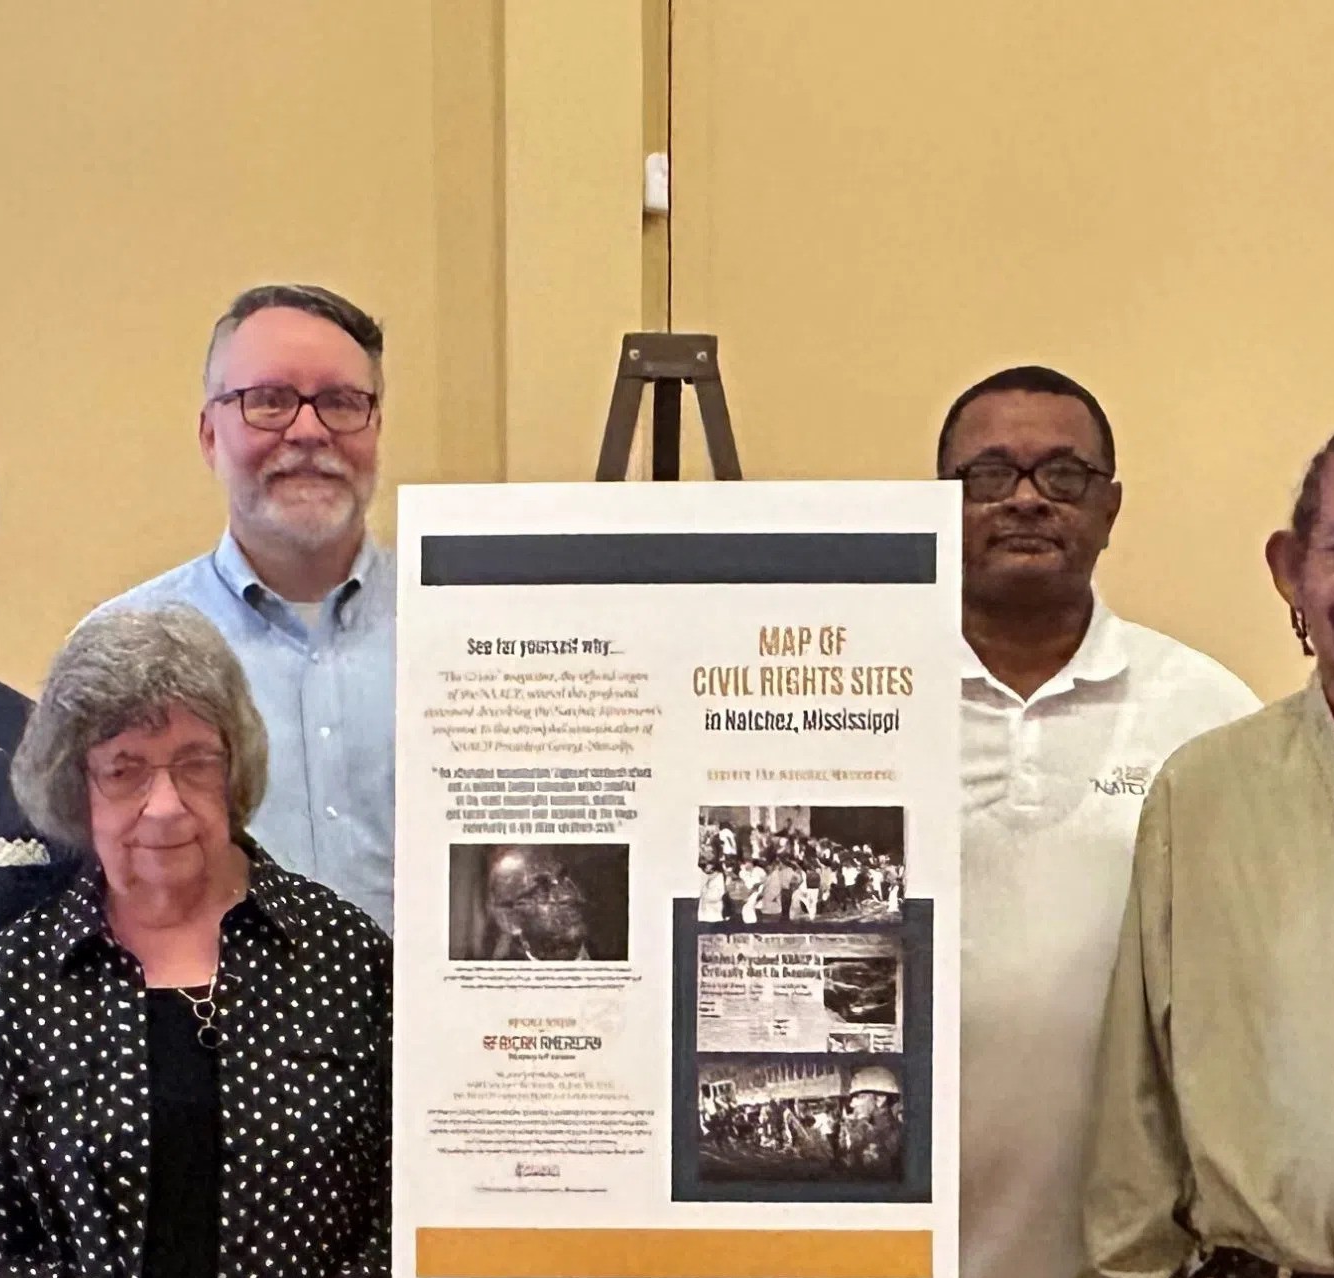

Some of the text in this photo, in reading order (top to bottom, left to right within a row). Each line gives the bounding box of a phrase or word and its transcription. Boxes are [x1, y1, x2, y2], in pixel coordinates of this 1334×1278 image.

[467, 638, 492, 656] See
[520, 638, 579, 658] yourself
[759, 626, 847, 656] MAP OF
[693, 666, 914, 697] CIVIL RIGHTS SITES
[705, 708, 900, 734] in Natchez, Mississippi
